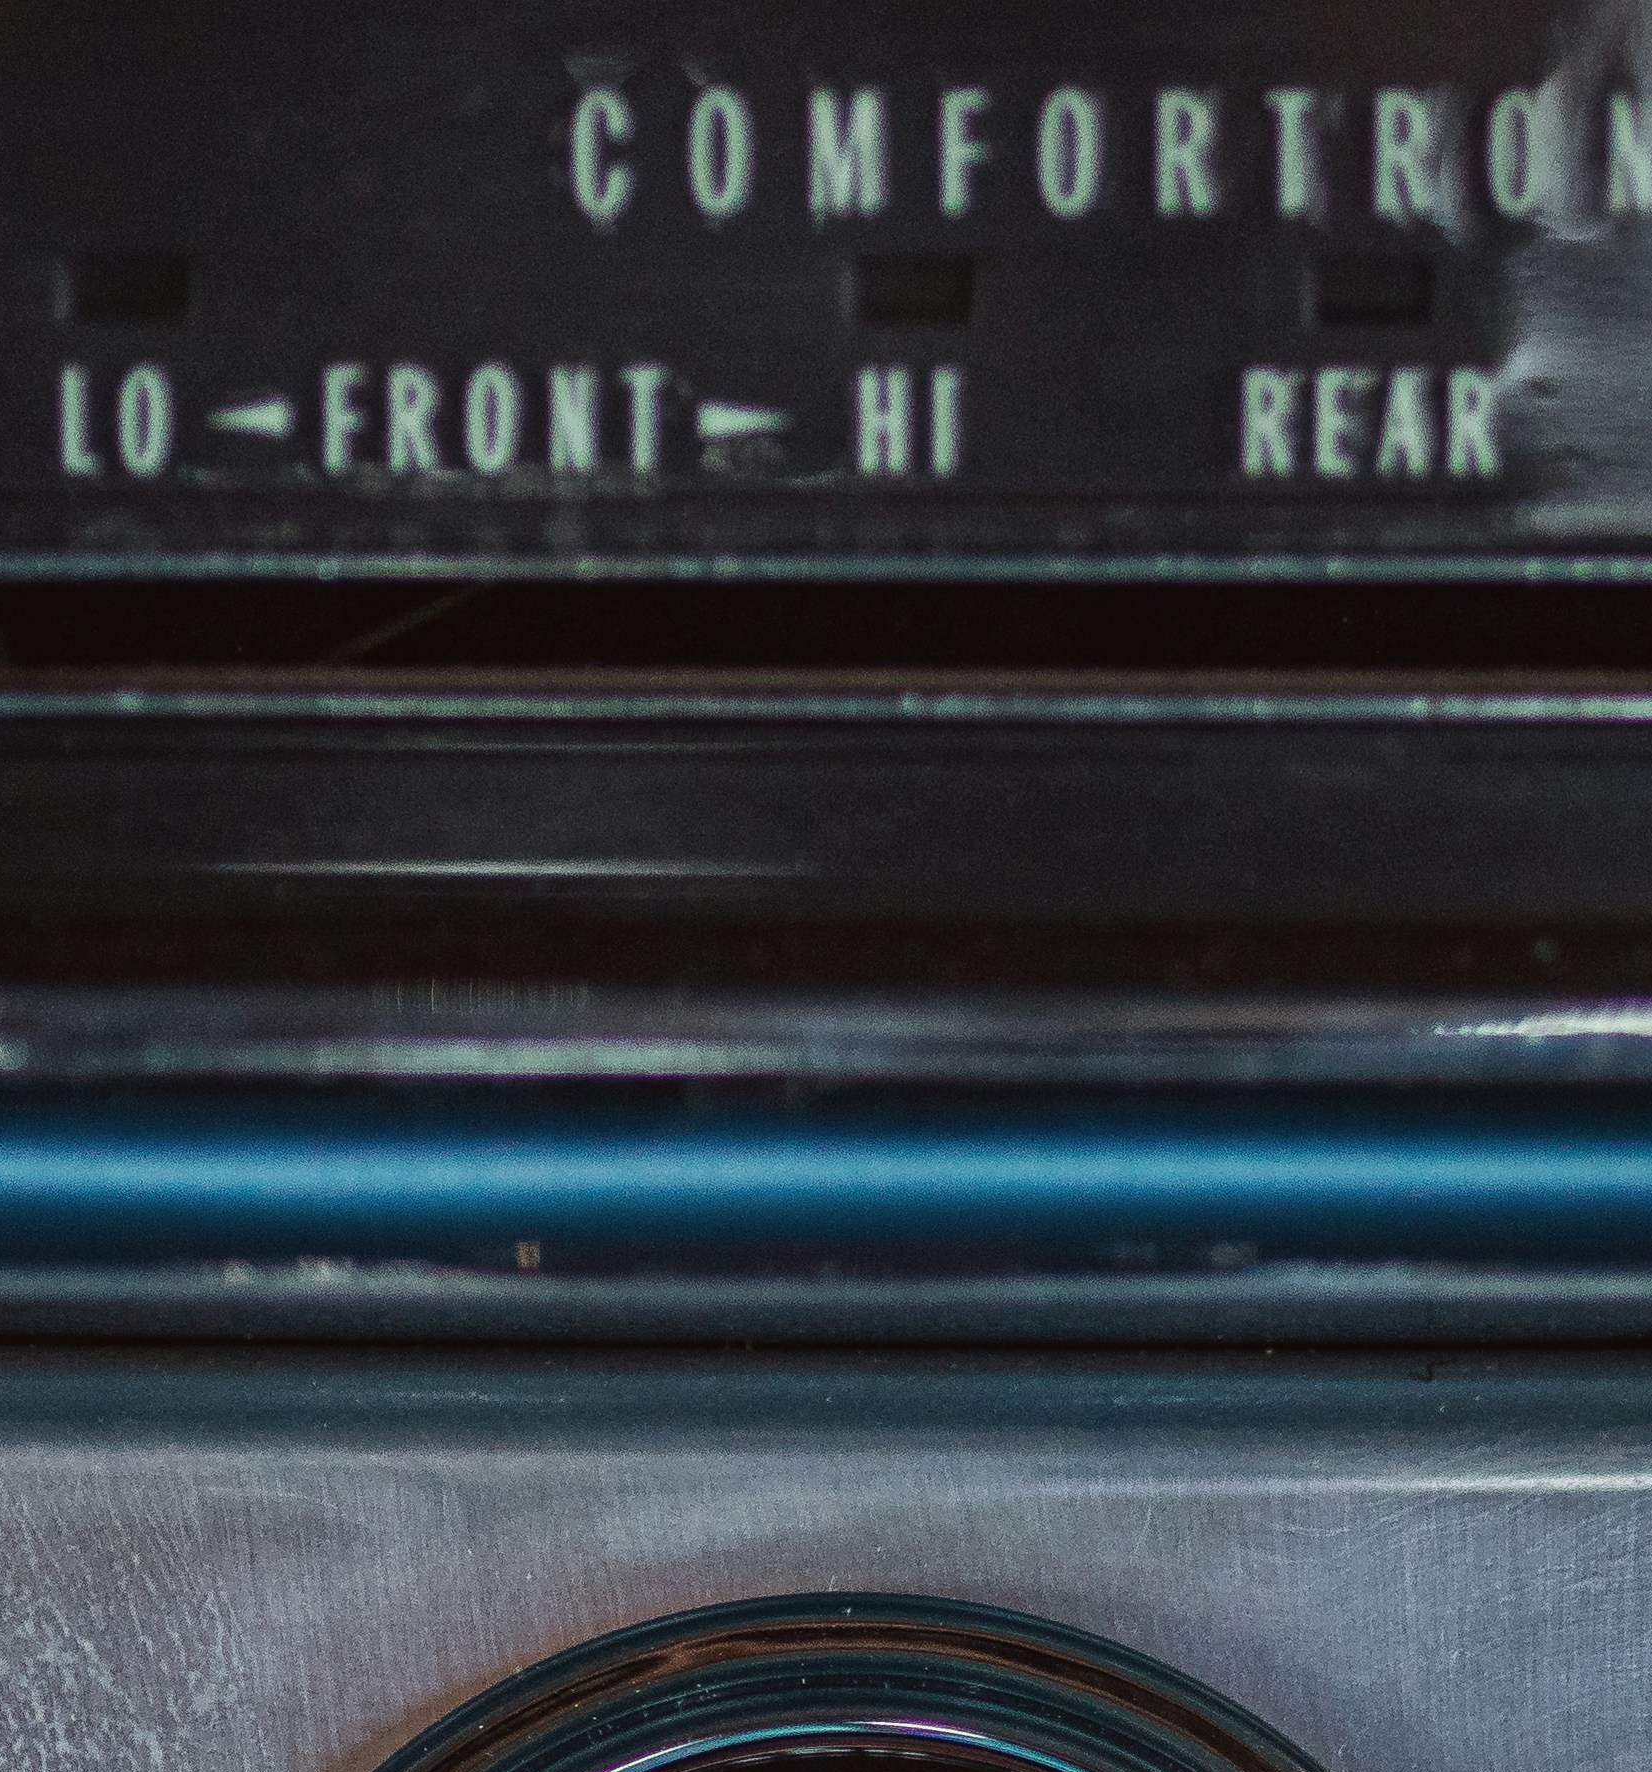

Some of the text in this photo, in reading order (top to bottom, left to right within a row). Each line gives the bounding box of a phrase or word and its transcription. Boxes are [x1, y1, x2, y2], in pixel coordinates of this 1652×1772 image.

[56, 361, 961, 480] LO FRONT HI
[1241, 367, 1501, 478] REAR
